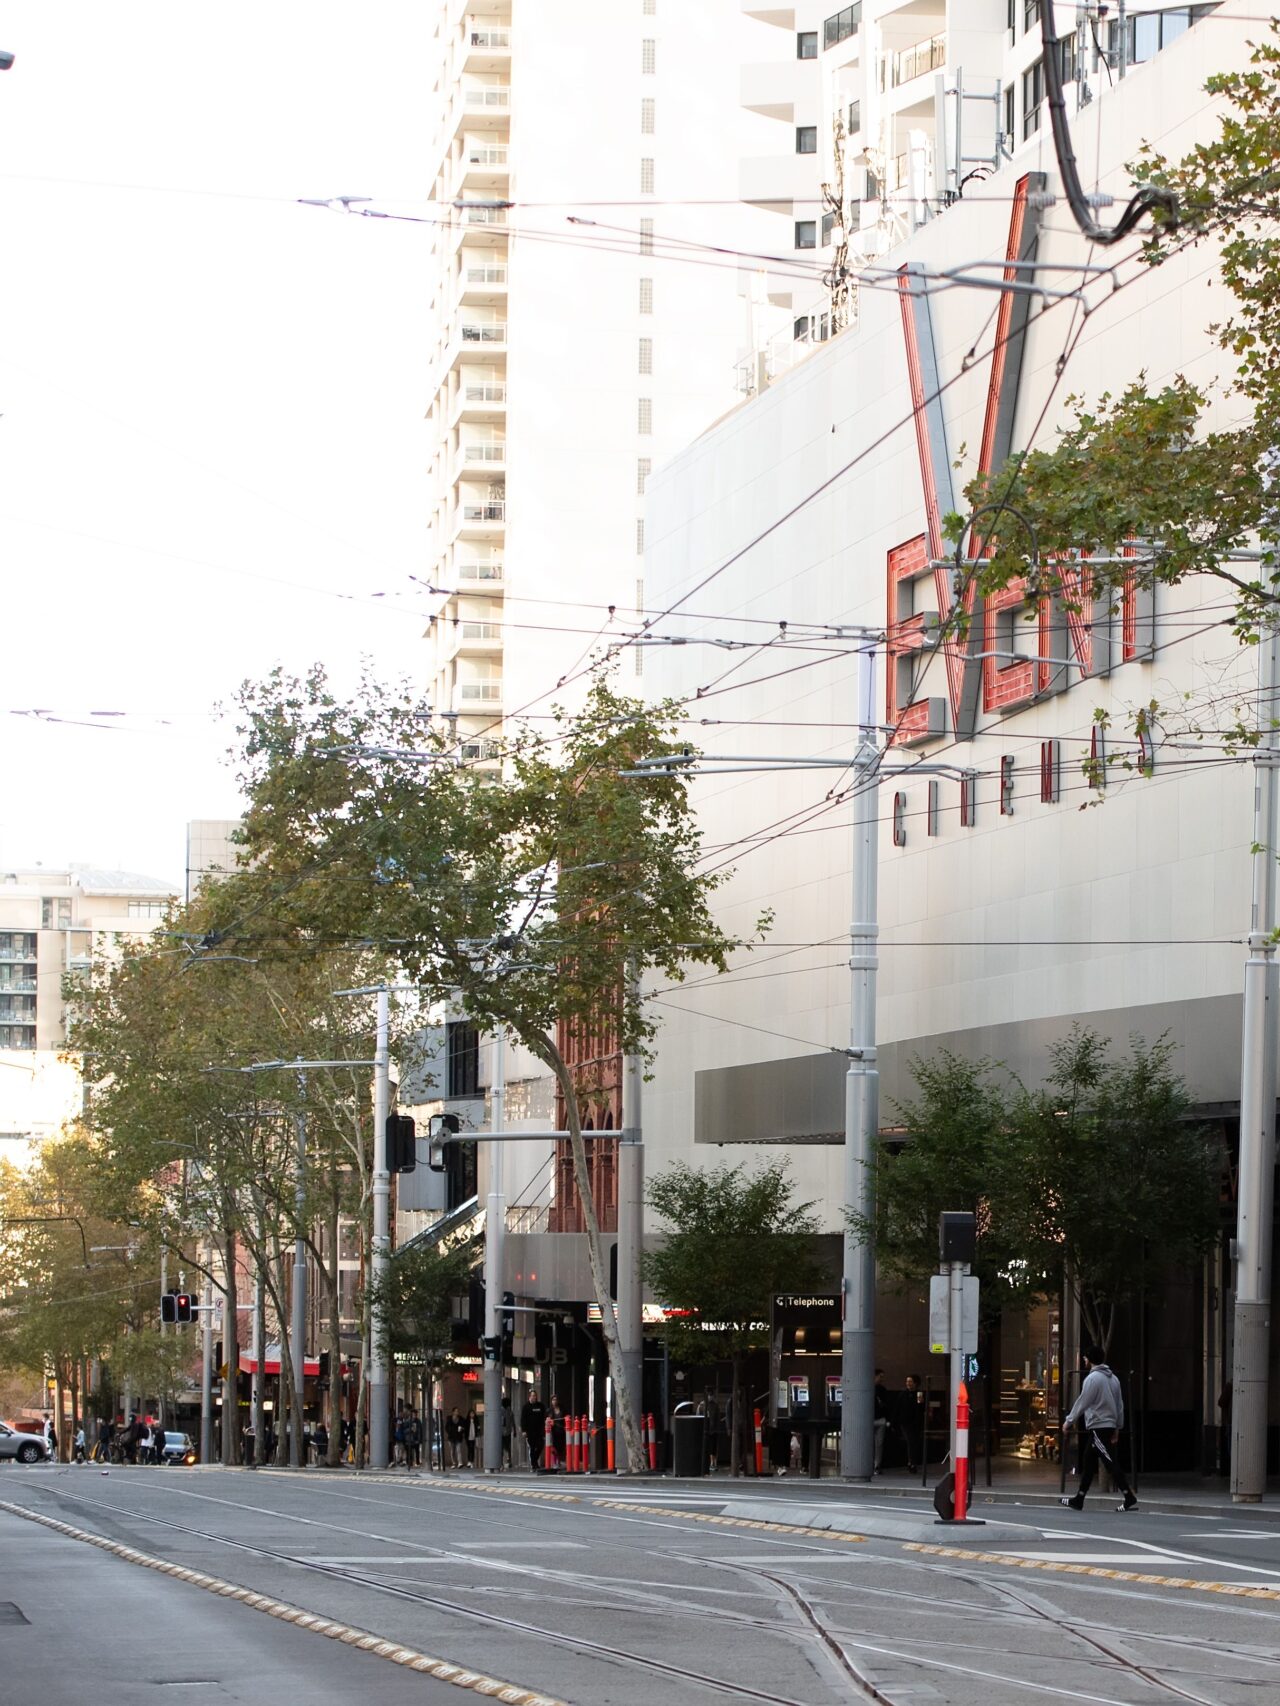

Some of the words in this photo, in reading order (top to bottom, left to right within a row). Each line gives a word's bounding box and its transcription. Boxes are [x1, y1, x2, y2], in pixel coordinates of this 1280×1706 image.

[886, 170, 1156, 747] EVENT
[893, 706, 1154, 846] CINEMAS
[788, 1297, 835, 1307] Telephone
